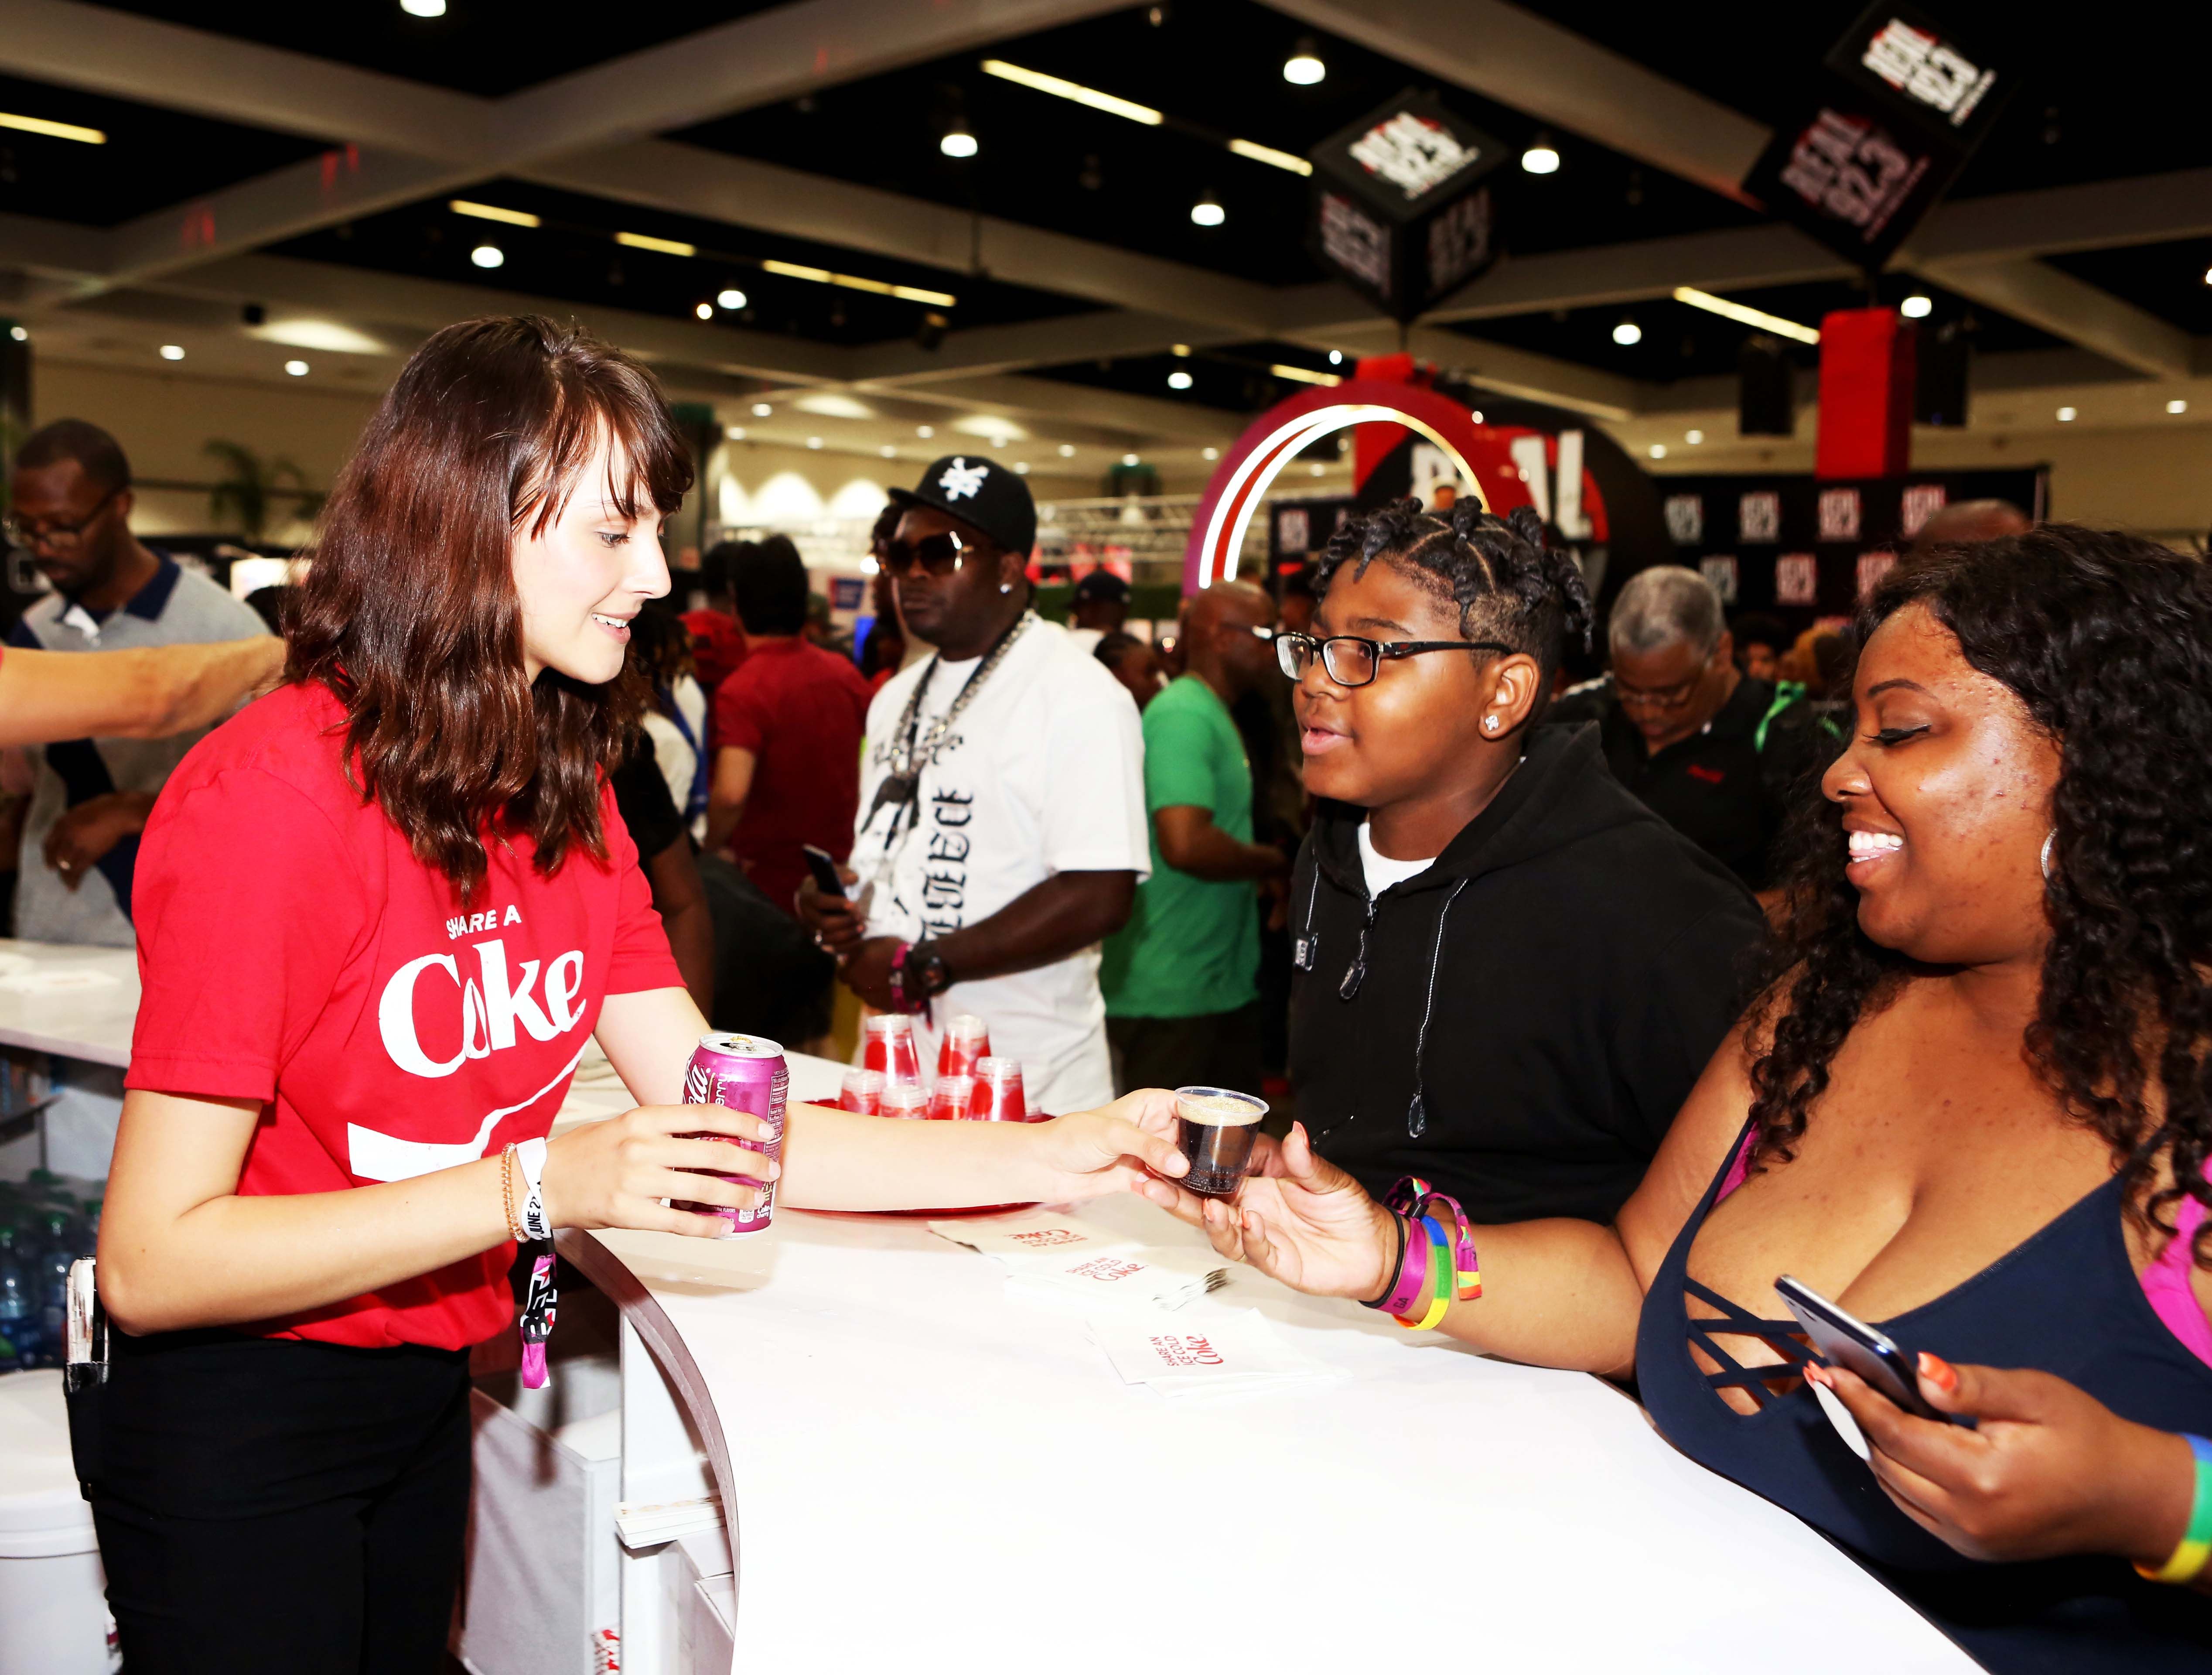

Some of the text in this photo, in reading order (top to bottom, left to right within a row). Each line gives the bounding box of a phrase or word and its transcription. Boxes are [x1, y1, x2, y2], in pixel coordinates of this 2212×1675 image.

[446, 905, 522, 940] SHARE A
[379, 939, 586, 1077] Coke
[527, 1211, 544, 1234] JUNE
[1092, 1264, 1145, 1281] Coke
[1095, 1260, 1122, 1271] COLD
[1148, 1337, 1180, 1366] SHARE AN
[1164, 1336, 1196, 1365] ICE COLD
[1186, 1335, 1224, 1365] Coke
